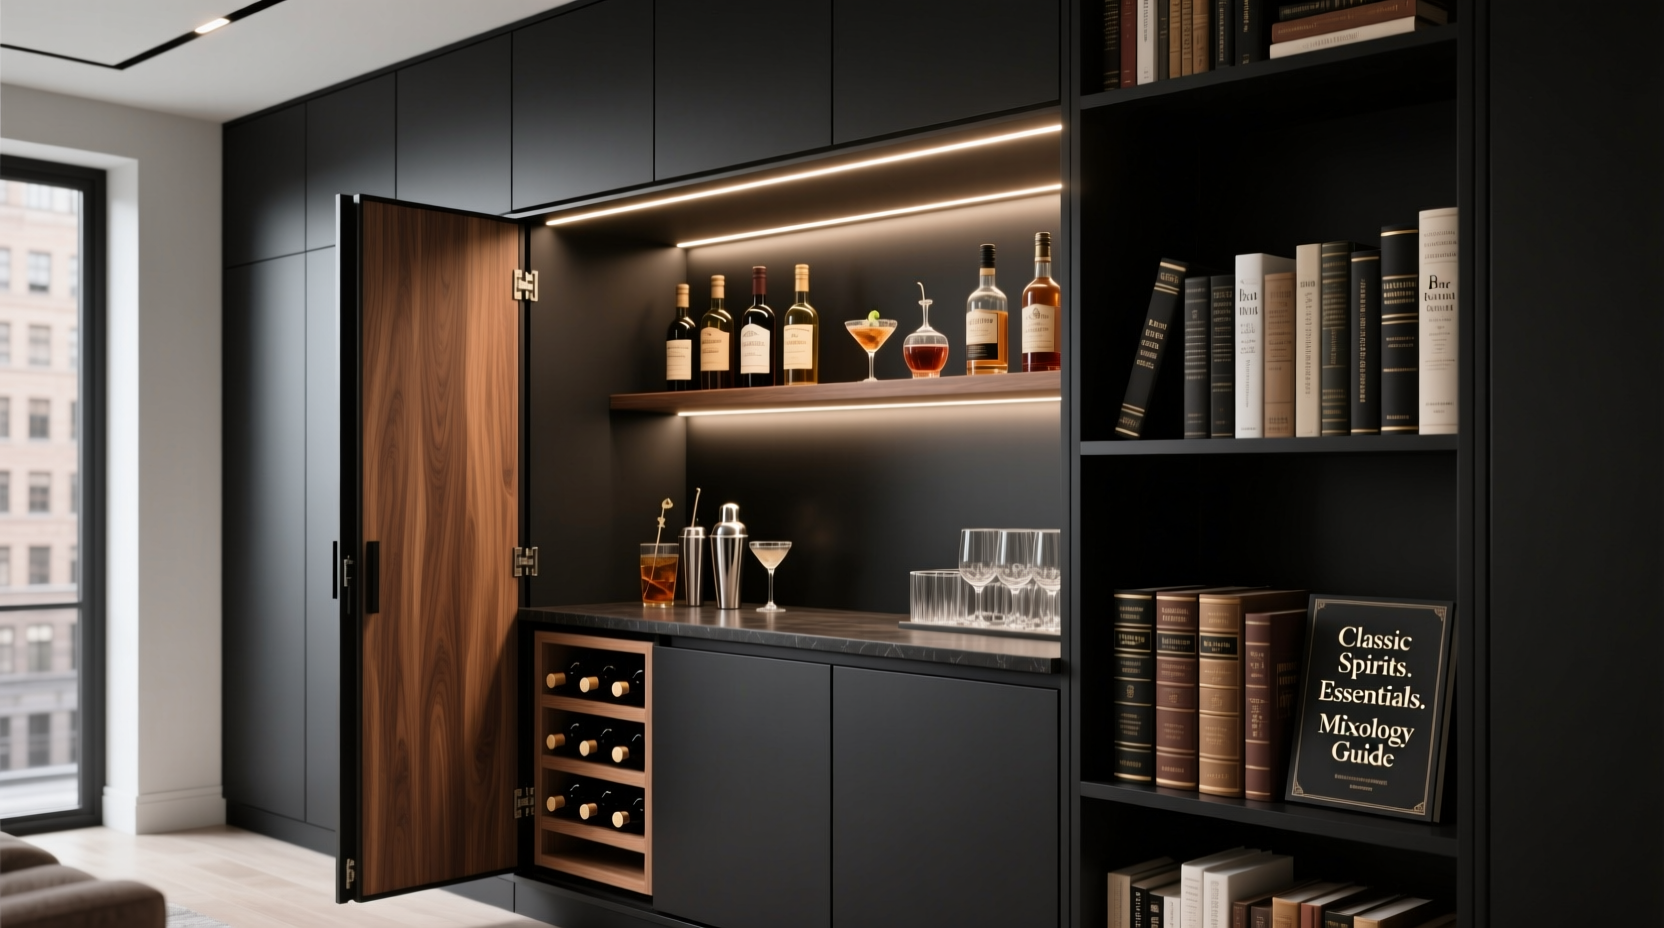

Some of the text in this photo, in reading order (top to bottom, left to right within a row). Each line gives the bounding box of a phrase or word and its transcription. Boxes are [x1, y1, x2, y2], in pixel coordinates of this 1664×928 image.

[1338, 626, 1413, 651] Classic
[1338, 652, 1413, 680] Spirits.
[1318, 679, 1426, 710] Essentials.
[1318, 713, 1415, 748] Mixology
[1331, 740, 1395, 768] Guide
